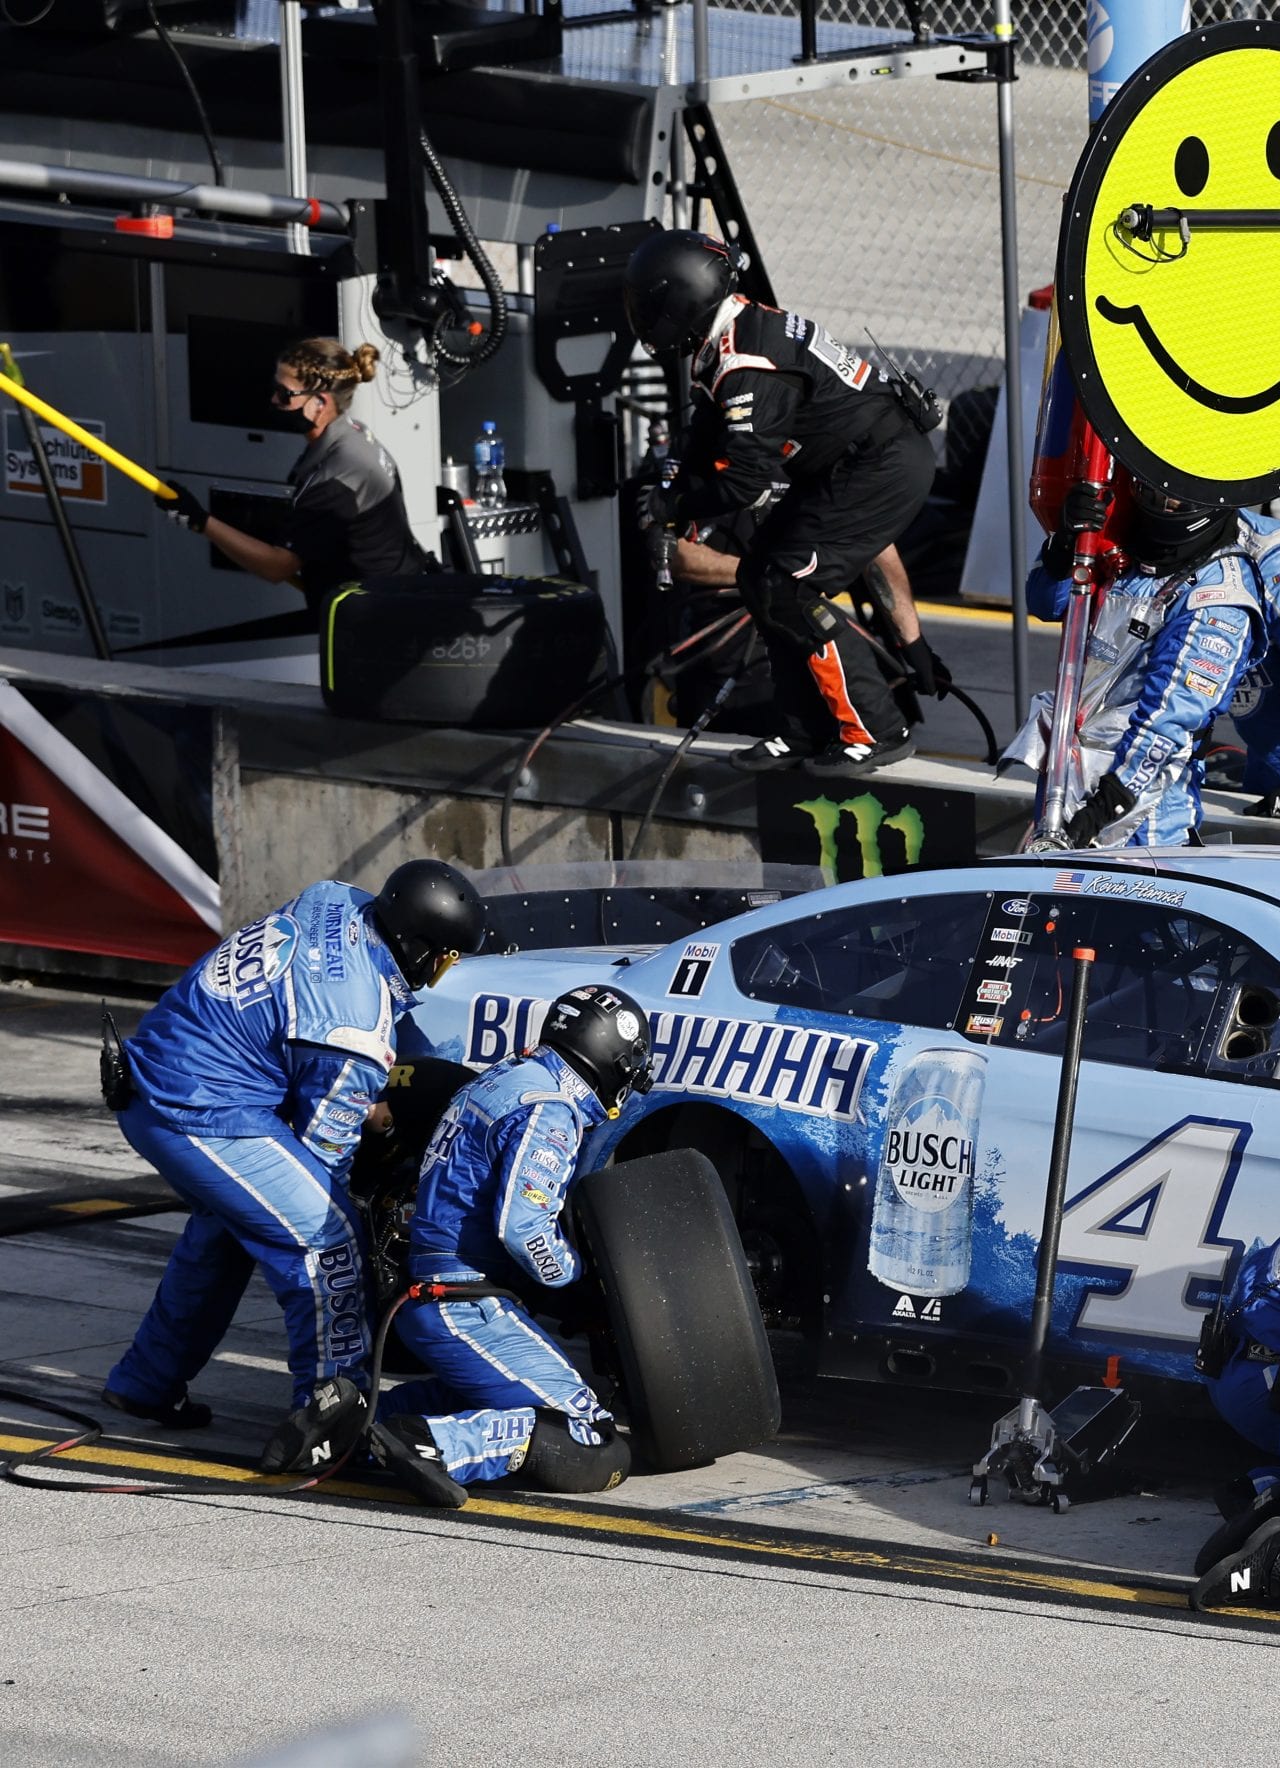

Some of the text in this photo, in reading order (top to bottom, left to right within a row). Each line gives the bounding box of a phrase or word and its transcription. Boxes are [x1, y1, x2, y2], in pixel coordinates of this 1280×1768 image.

[7, 452, 79, 480] Sysms
[1201, 637, 1232, 658] BUSCH
[1126, 733, 1176, 796] BUSCH
[1084, 874, 1187, 907] Kevin Harvick
[326, 902, 345, 980] MORNEAU
[993, 929, 1019, 942] Mobil
[684, 943, 718, 958] Mobil
[985, 955, 1023, 968] HAAS
[681, 961, 700, 992] 1
[559, 1066, 591, 1100] BUSCH
[529, 1149, 561, 1174] BUSCH
[886, 1129, 973, 1175] BUSCH
[899, 1169, 957, 1193] LIGHT
[1036, 1114, 1253, 1346] 4
[525, 1232, 563, 1284] BUSCH
[318, 1243, 364, 1359] BUSCH
[892, 1309, 917, 1319] AXALTA
[1230, 1567, 1251, 1593] N
